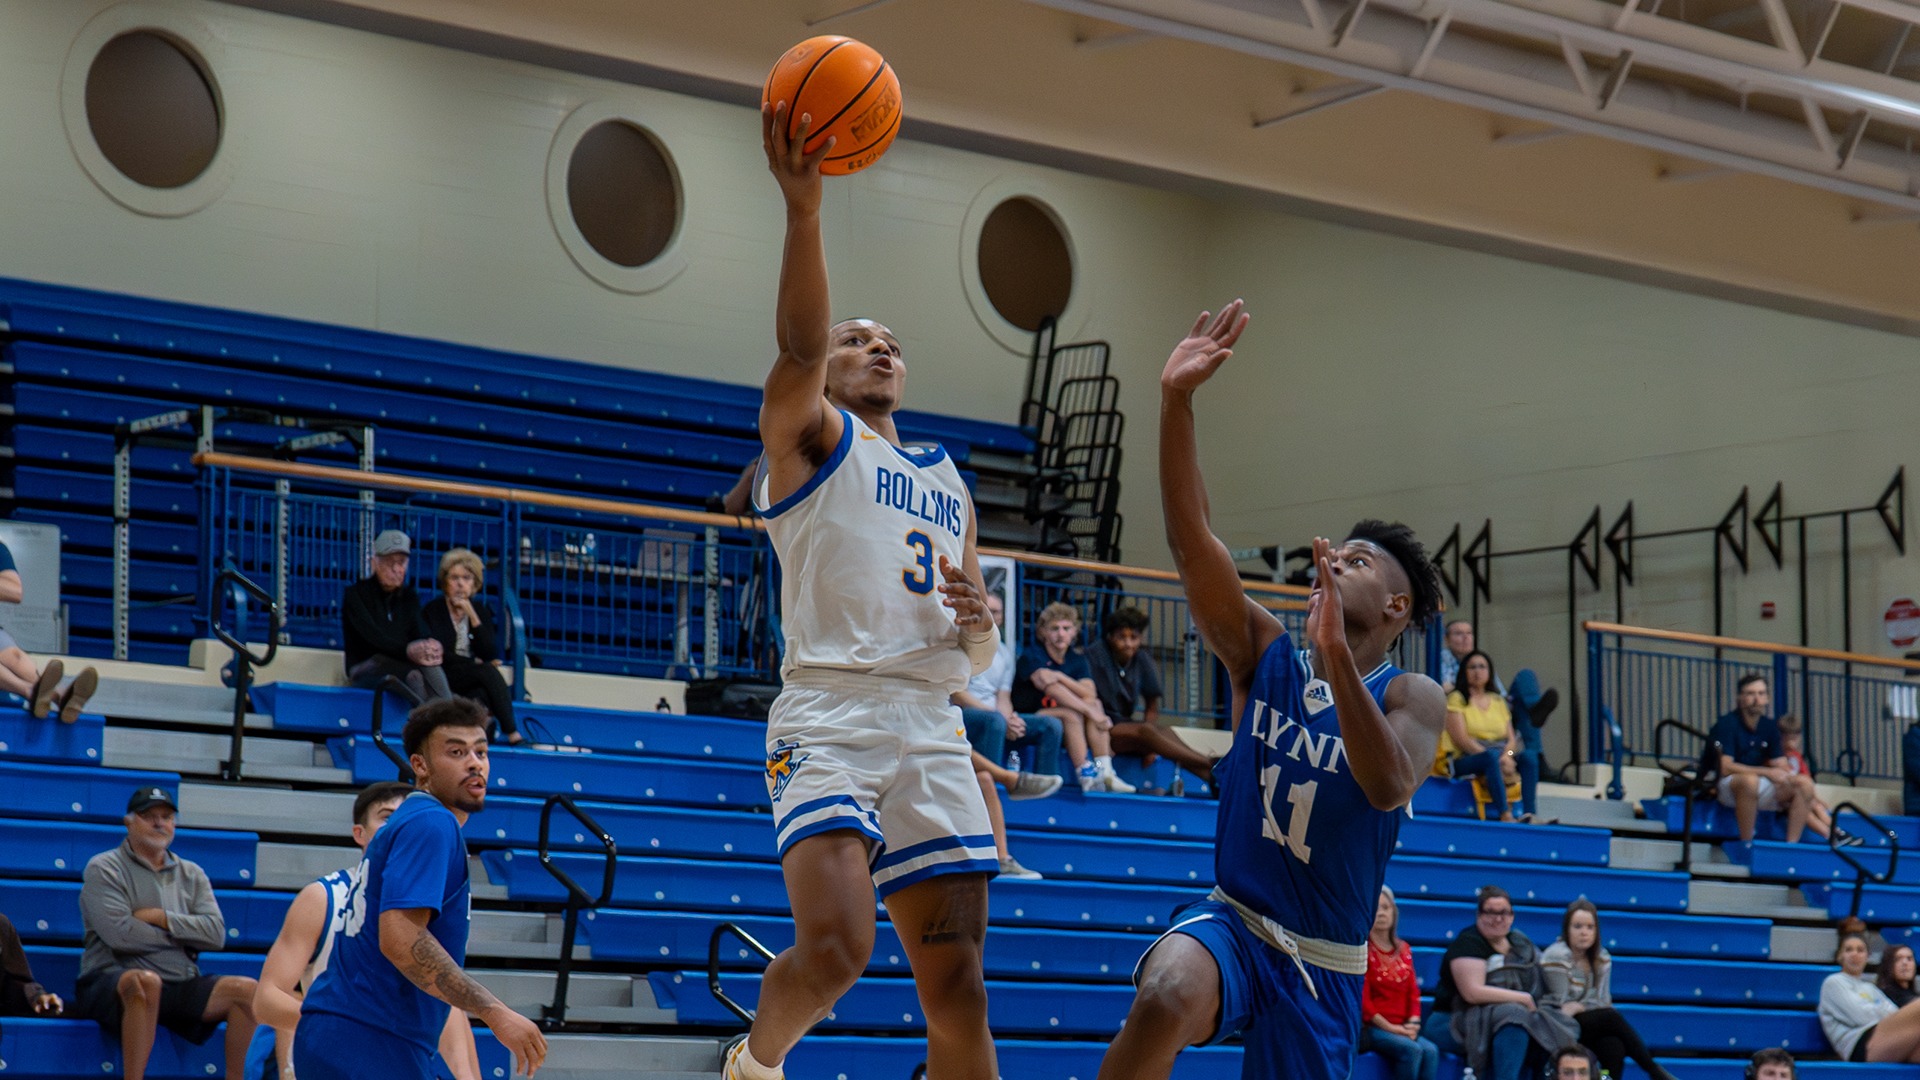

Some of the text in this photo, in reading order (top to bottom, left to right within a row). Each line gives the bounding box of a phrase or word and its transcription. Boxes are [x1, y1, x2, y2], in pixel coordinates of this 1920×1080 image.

[876, 466, 961, 537] ROLLINS
[902, 528, 935, 596] 3
[1305, 691, 1330, 704] adidas
[1260, 763, 1318, 864] 11
